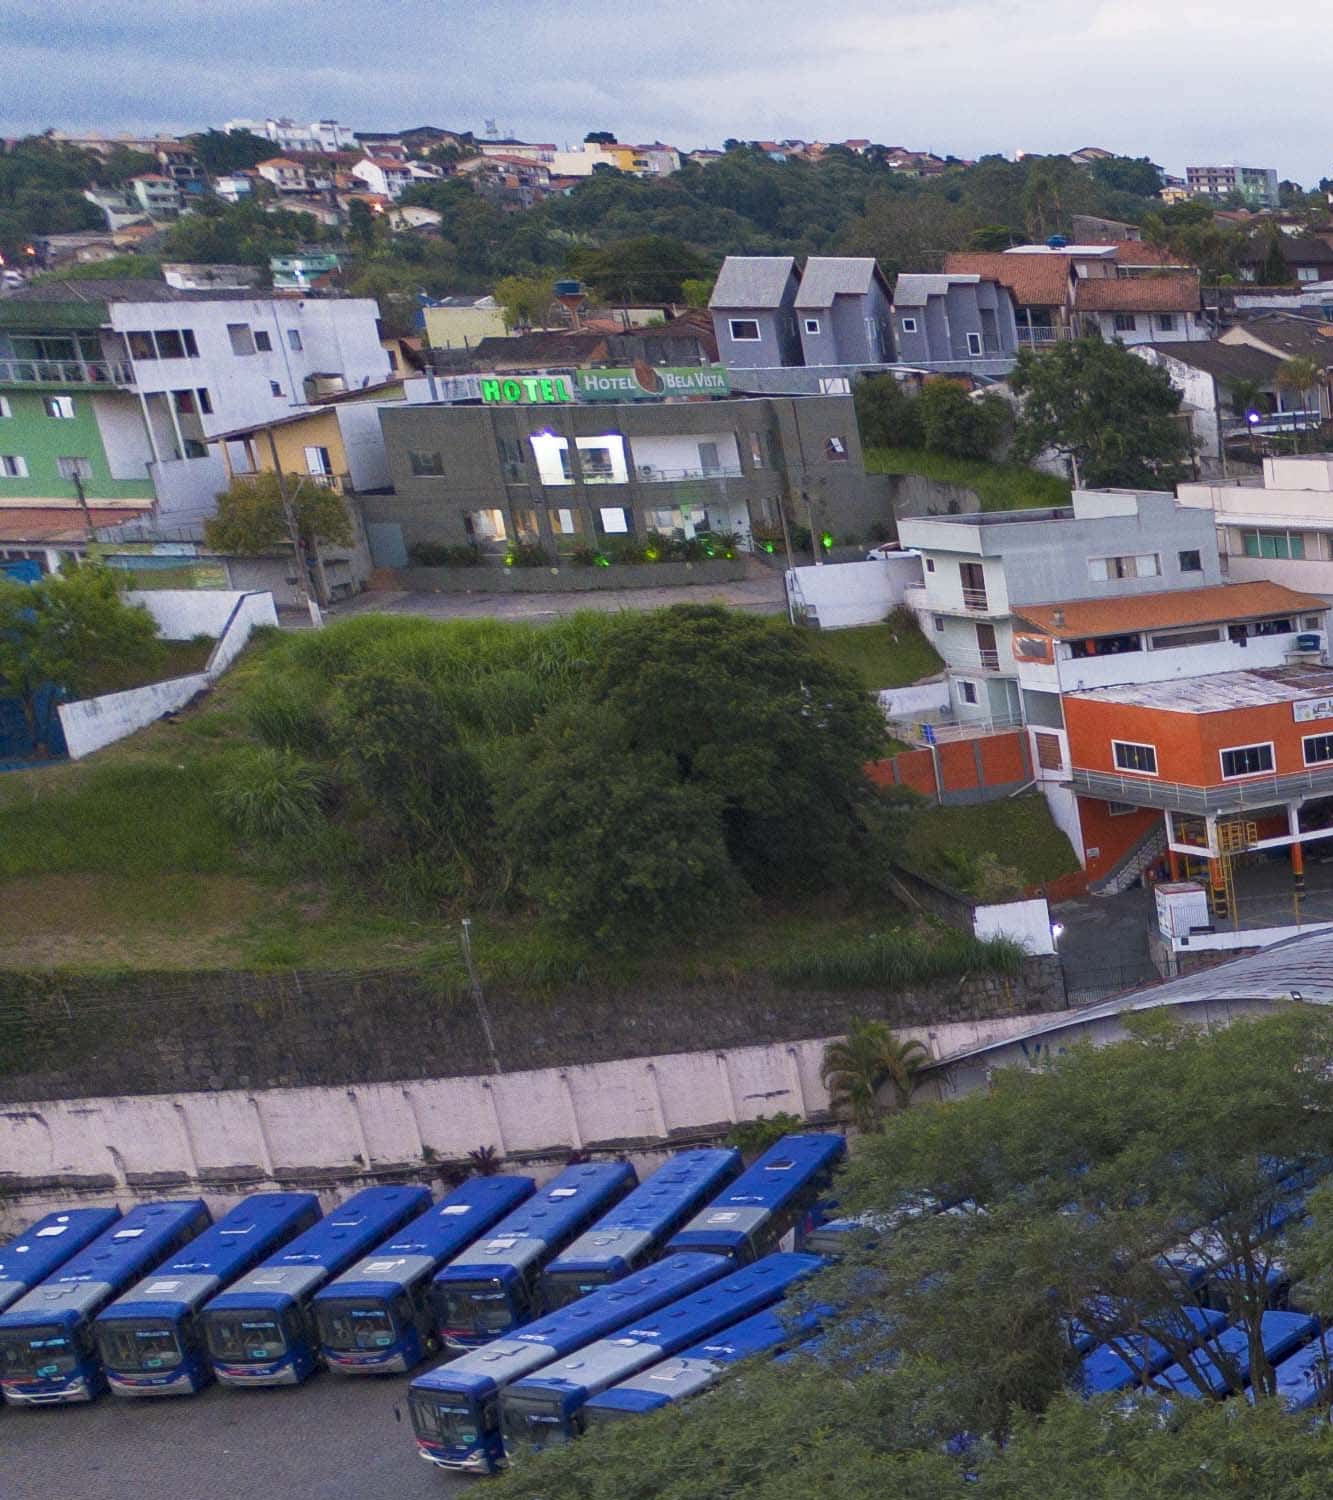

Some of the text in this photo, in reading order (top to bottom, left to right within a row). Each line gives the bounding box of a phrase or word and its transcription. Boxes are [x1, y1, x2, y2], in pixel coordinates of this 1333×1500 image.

[481, 379, 570, 402] HOTEL
[584, 372, 725, 391] HOTEL BELA VISTA
